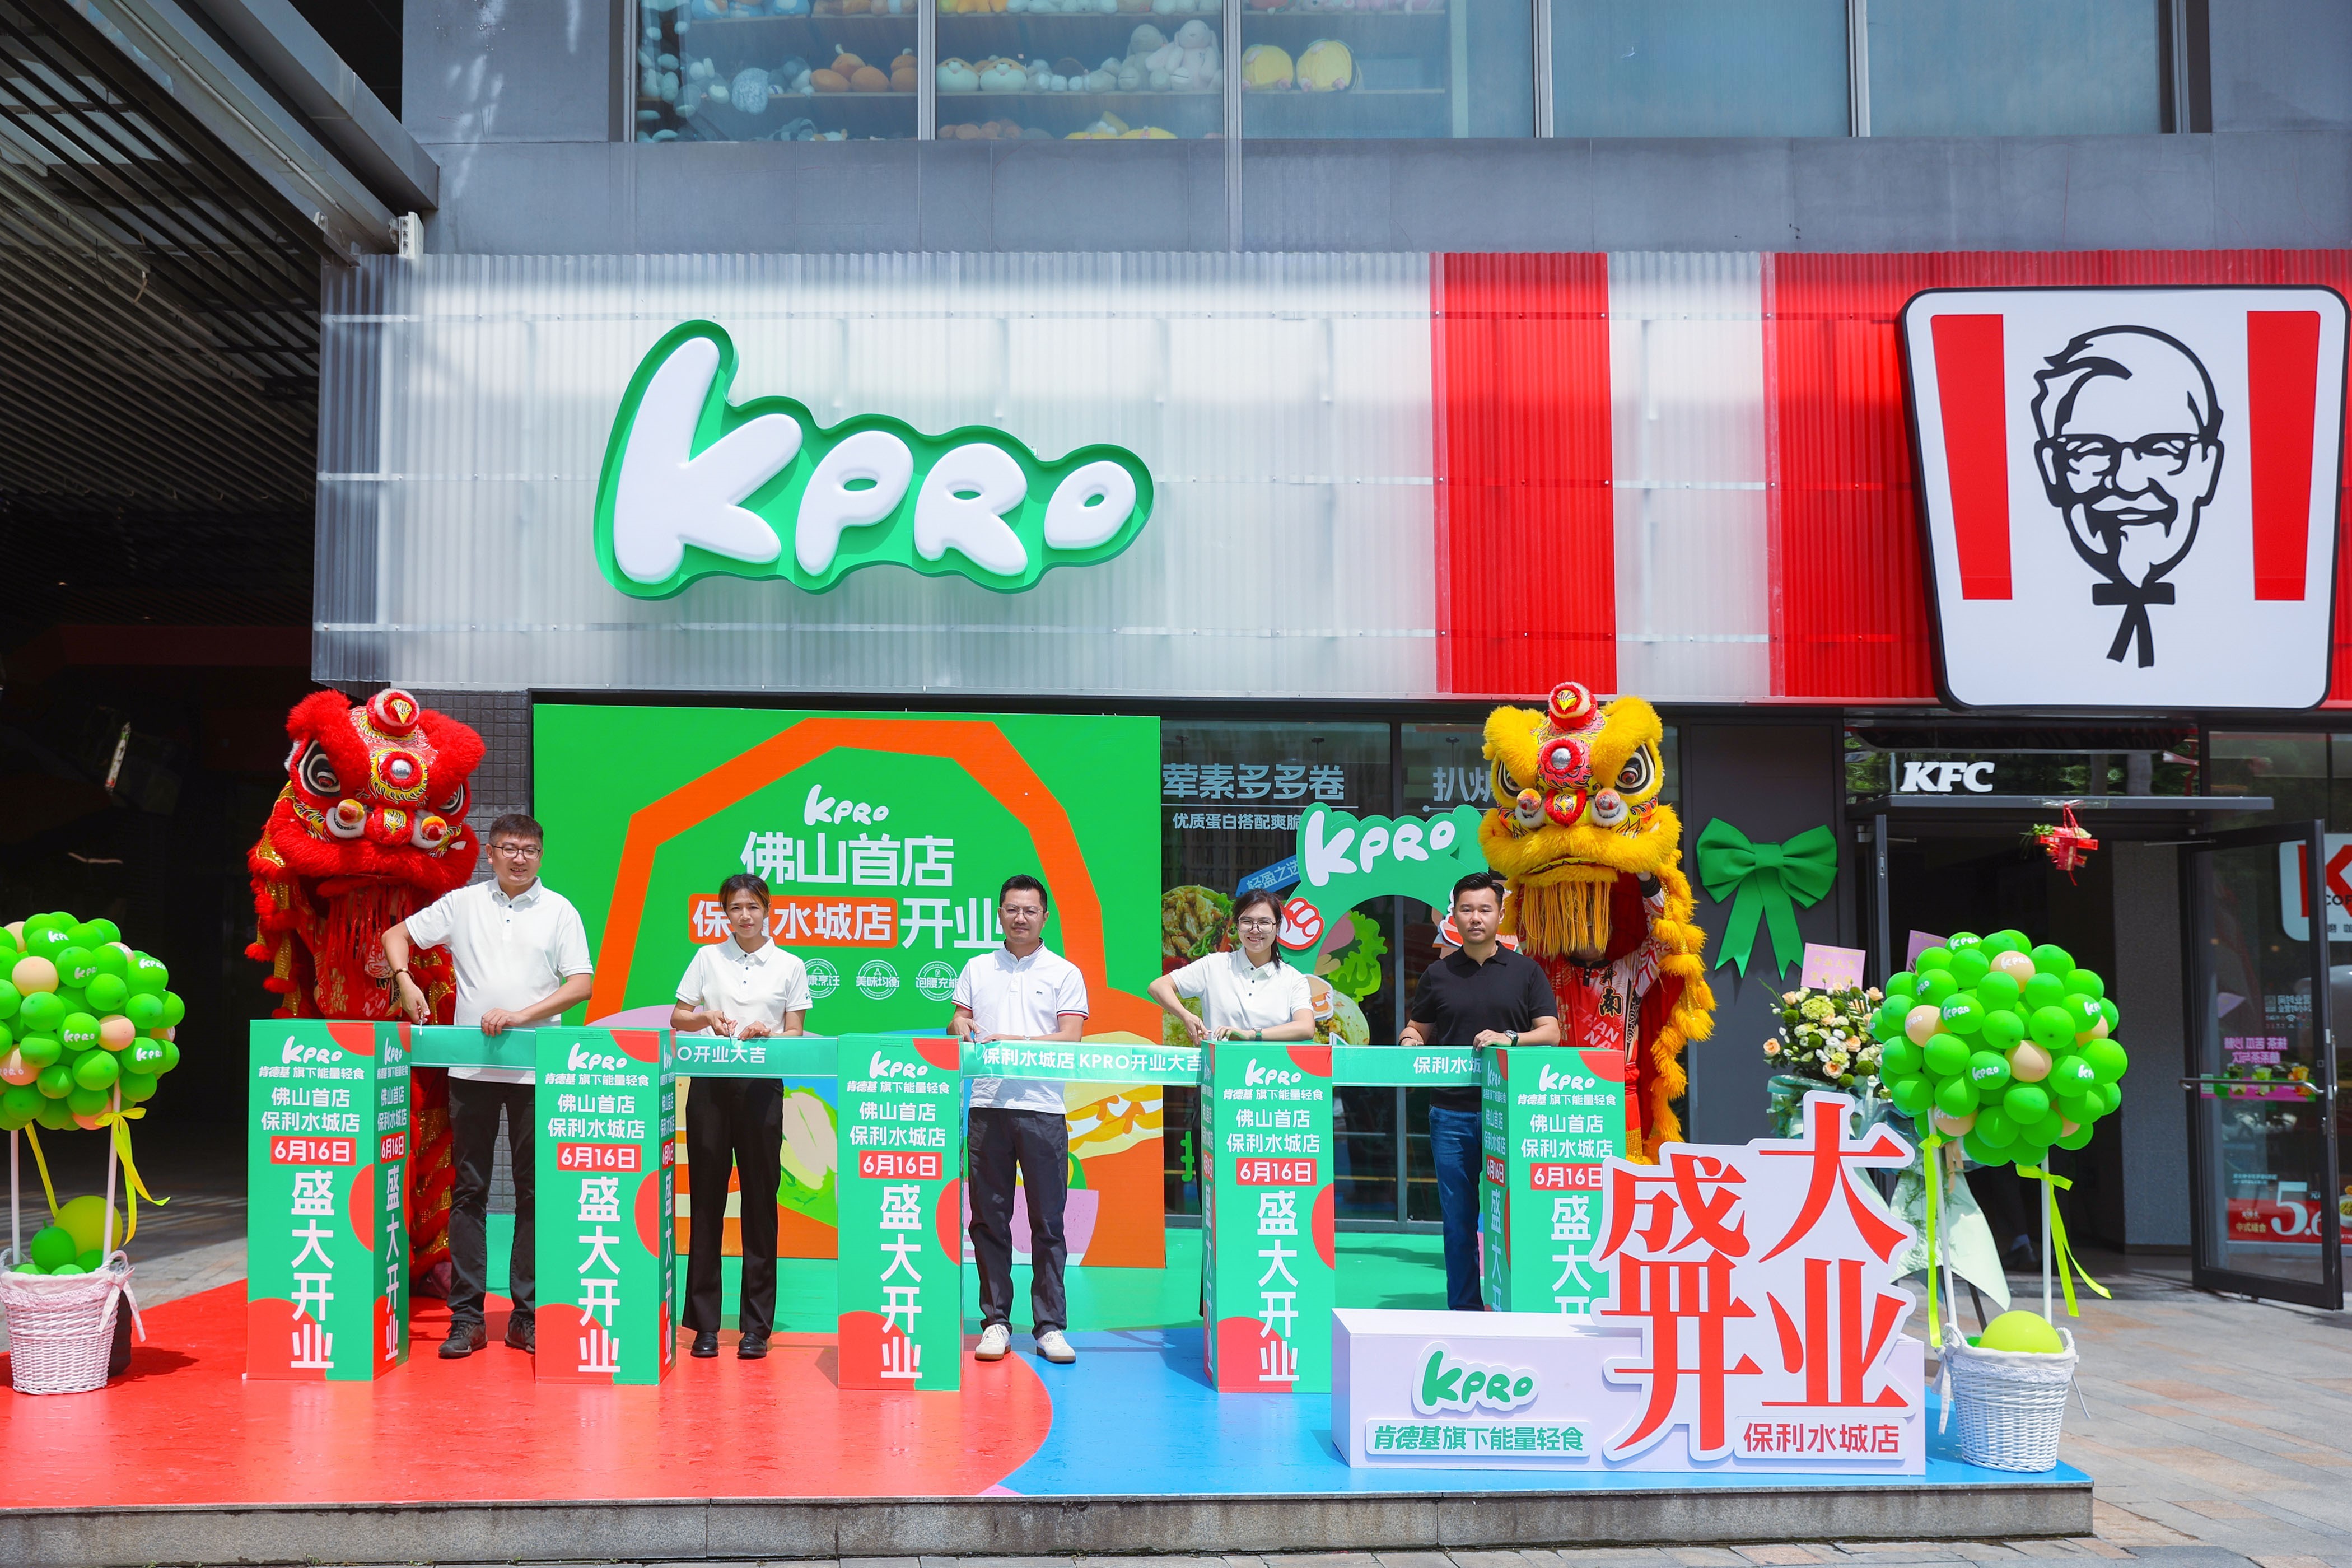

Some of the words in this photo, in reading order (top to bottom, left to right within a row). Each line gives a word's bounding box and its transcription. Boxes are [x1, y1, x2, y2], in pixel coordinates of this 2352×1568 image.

[614, 337, 1137, 585] KPRO
[1162, 763, 1344, 800] 荤素多多卷
[1900, 762, 1995, 792] KFC
[805, 785, 888, 825] KPRO
[1304, 810, 1456, 886] KPRO
[740, 832, 954, 886] 佛山首店
[693, 900, 892, 941] 保水城店
[901, 898, 1004, 949] 开业
[74, 967, 97, 979] KPR
[807, 974, 840, 987] 康烹饪
[856, 976, 900, 988] 美味均衡
[916, 977, 959, 989] 饱腹充能
[64, 1030, 95, 1042] KPRO
[282, 1036, 342, 1063] KPRO
[568, 1043, 627, 1071] KPRO
[983, 1047, 1075, 1070] 保利水城店
[1079, 1053, 1201, 1072] KPRO开业大吉
[259, 1066, 290, 1077] 肯德基
[293, 1067, 364, 1079] 旗下能量轻食
[870, 1051, 927, 1078] KPRO
[1245, 1059, 1301, 1086] KPRO
[545, 1073, 575, 1084] 肯德基
[579, 1074, 648, 1086] 旗下能量轻食
[847, 1081, 877, 1092] 肯德基
[881, 1082, 949, 1093] 旗下能量轻食
[1539, 1063, 1595, 1091] KPRO
[272, 1088, 349, 1107] 佛山首店
[558, 1094, 634, 1113] 佛山首店
[1224, 1089, 1253, 1099] 肯德基
[1257, 1089, 1322, 1100] 旗下能量轻食
[1517, 1094, 1547, 1105] 肯德基
[1550, 1094, 1616, 1106] 旗下能量轻食
[860, 1102, 935, 1121] 佛山首店
[1236, 1109, 1309, 1127] 佛山首店
[262, 1112, 360, 1132] 保利水城店
[548, 1118, 644, 1138] 保利水城店
[1530, 1114, 1604, 1134] 佛山首店
[850, 1126, 945, 1146] 保利水城店
[1227, 1134, 1319, 1152] 保利水城店
[275, 1141, 349, 1161] 6月16日
[562, 1147, 634, 1168] 6月16日
[1520, 1138, 1613, 1159] 保利水城店
[864, 1155, 935, 1175] 6月16日
[1240, 1162, 1310, 1182] 6月16日
[1534, 1168, 1602, 1188] 6月16日
[291, 1170, 334, 1368] 盛大开业
[578, 1177, 620, 1373] 盛大开业
[880, 1184, 922, 1378] 盛大开业
[1258, 1191, 1299, 1381] 盛大开业
[1422, 1350, 1534, 1407] KPRO
[1374, 1426, 1584, 1452] 肯德基旗下能量轻食
[1743, 1423, 1900, 1454] 保利水城店
